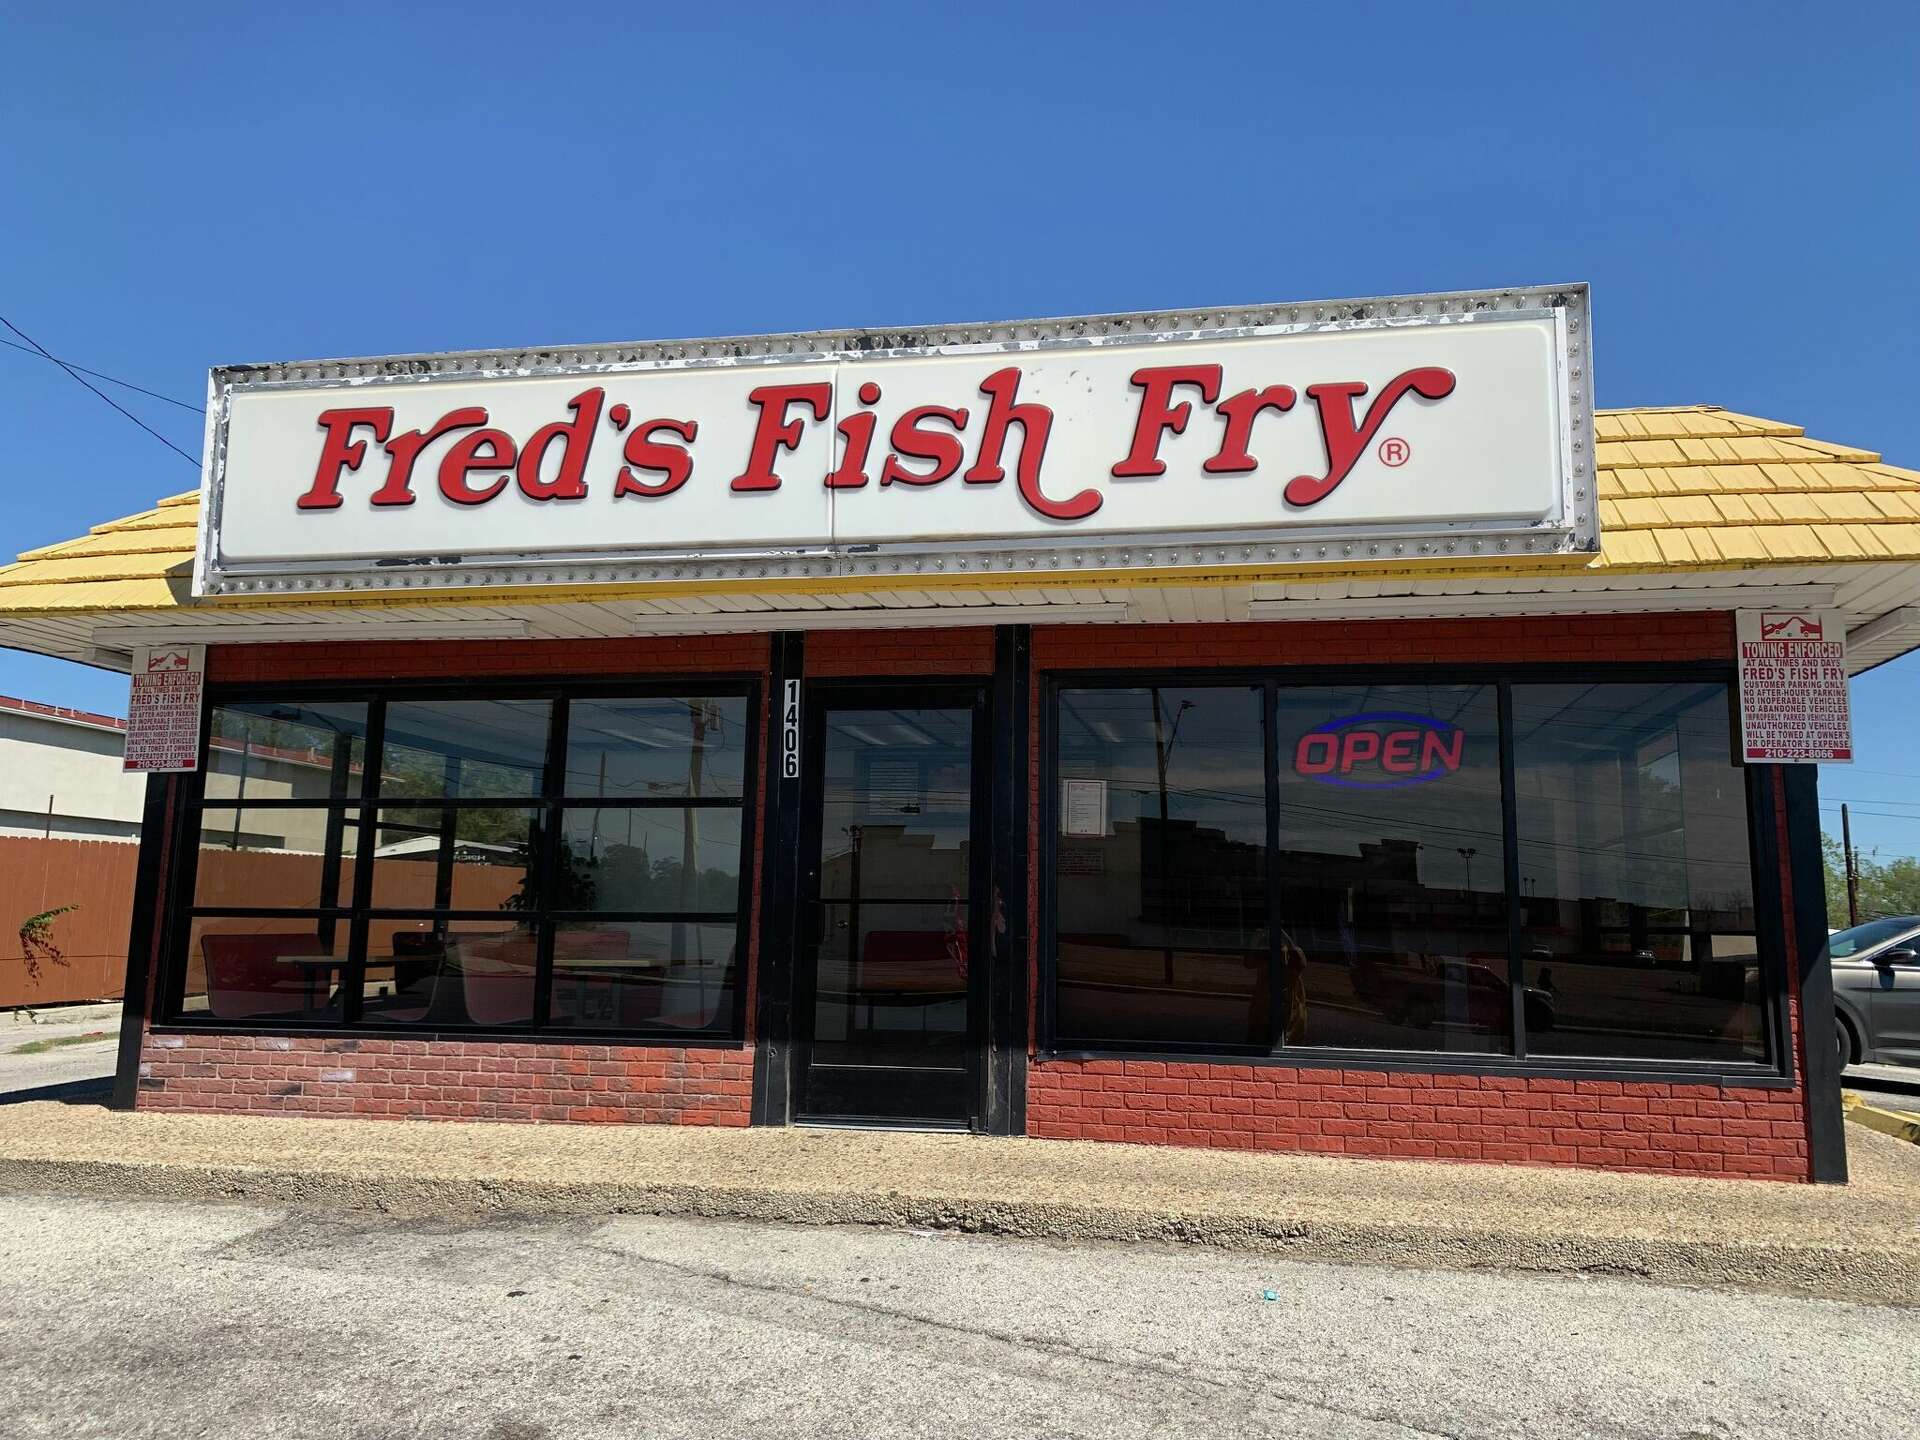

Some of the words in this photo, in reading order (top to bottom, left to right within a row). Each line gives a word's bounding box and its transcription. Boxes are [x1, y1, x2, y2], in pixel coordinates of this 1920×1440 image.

[296, 386, 699, 510] Fred's
[729, 367, 1104, 520] Fish
[1111, 363, 1457, 507] Fry
[1744, 642, 1785, 658] TOWING
[1788, 642, 1841, 658] ENFORCED
[136, 673, 163, 687] TOWING
[163, 672, 200, 686] ENFORCED
[1743, 668, 1785, 680] FRED'S
[1790, 668, 1818, 680] FISH
[1823, 668, 1845, 680] FRY
[131, 694, 160, 704] FRED'S
[162, 694, 181, 704] FISH
[184, 693, 200, 703] FRY
[1744, 689, 1754, 697] NO
[1813, 689, 1847, 697] PARKING
[1745, 705, 1755, 713] NO
[1758, 705, 1806, 713] ABANDONED
[1809, 705, 1848, 713] VEHICLES
[785, 681, 797, 776] 1406
[1746, 731, 1764, 739] WILL
[1766, 731, 1775, 739] BE
[1779, 731, 1803, 739] TOWED
[1806, 731, 1814, 739] AT
[1817, 731, 1850, 739] OWNER'S
[1747, 740, 1758, 748] OR
[1761, 740, 1809, 748] OPERATOR'S
[1295, 729, 1464, 774] OPEN
[1765, 749, 1834, 758] 210-223-8066
